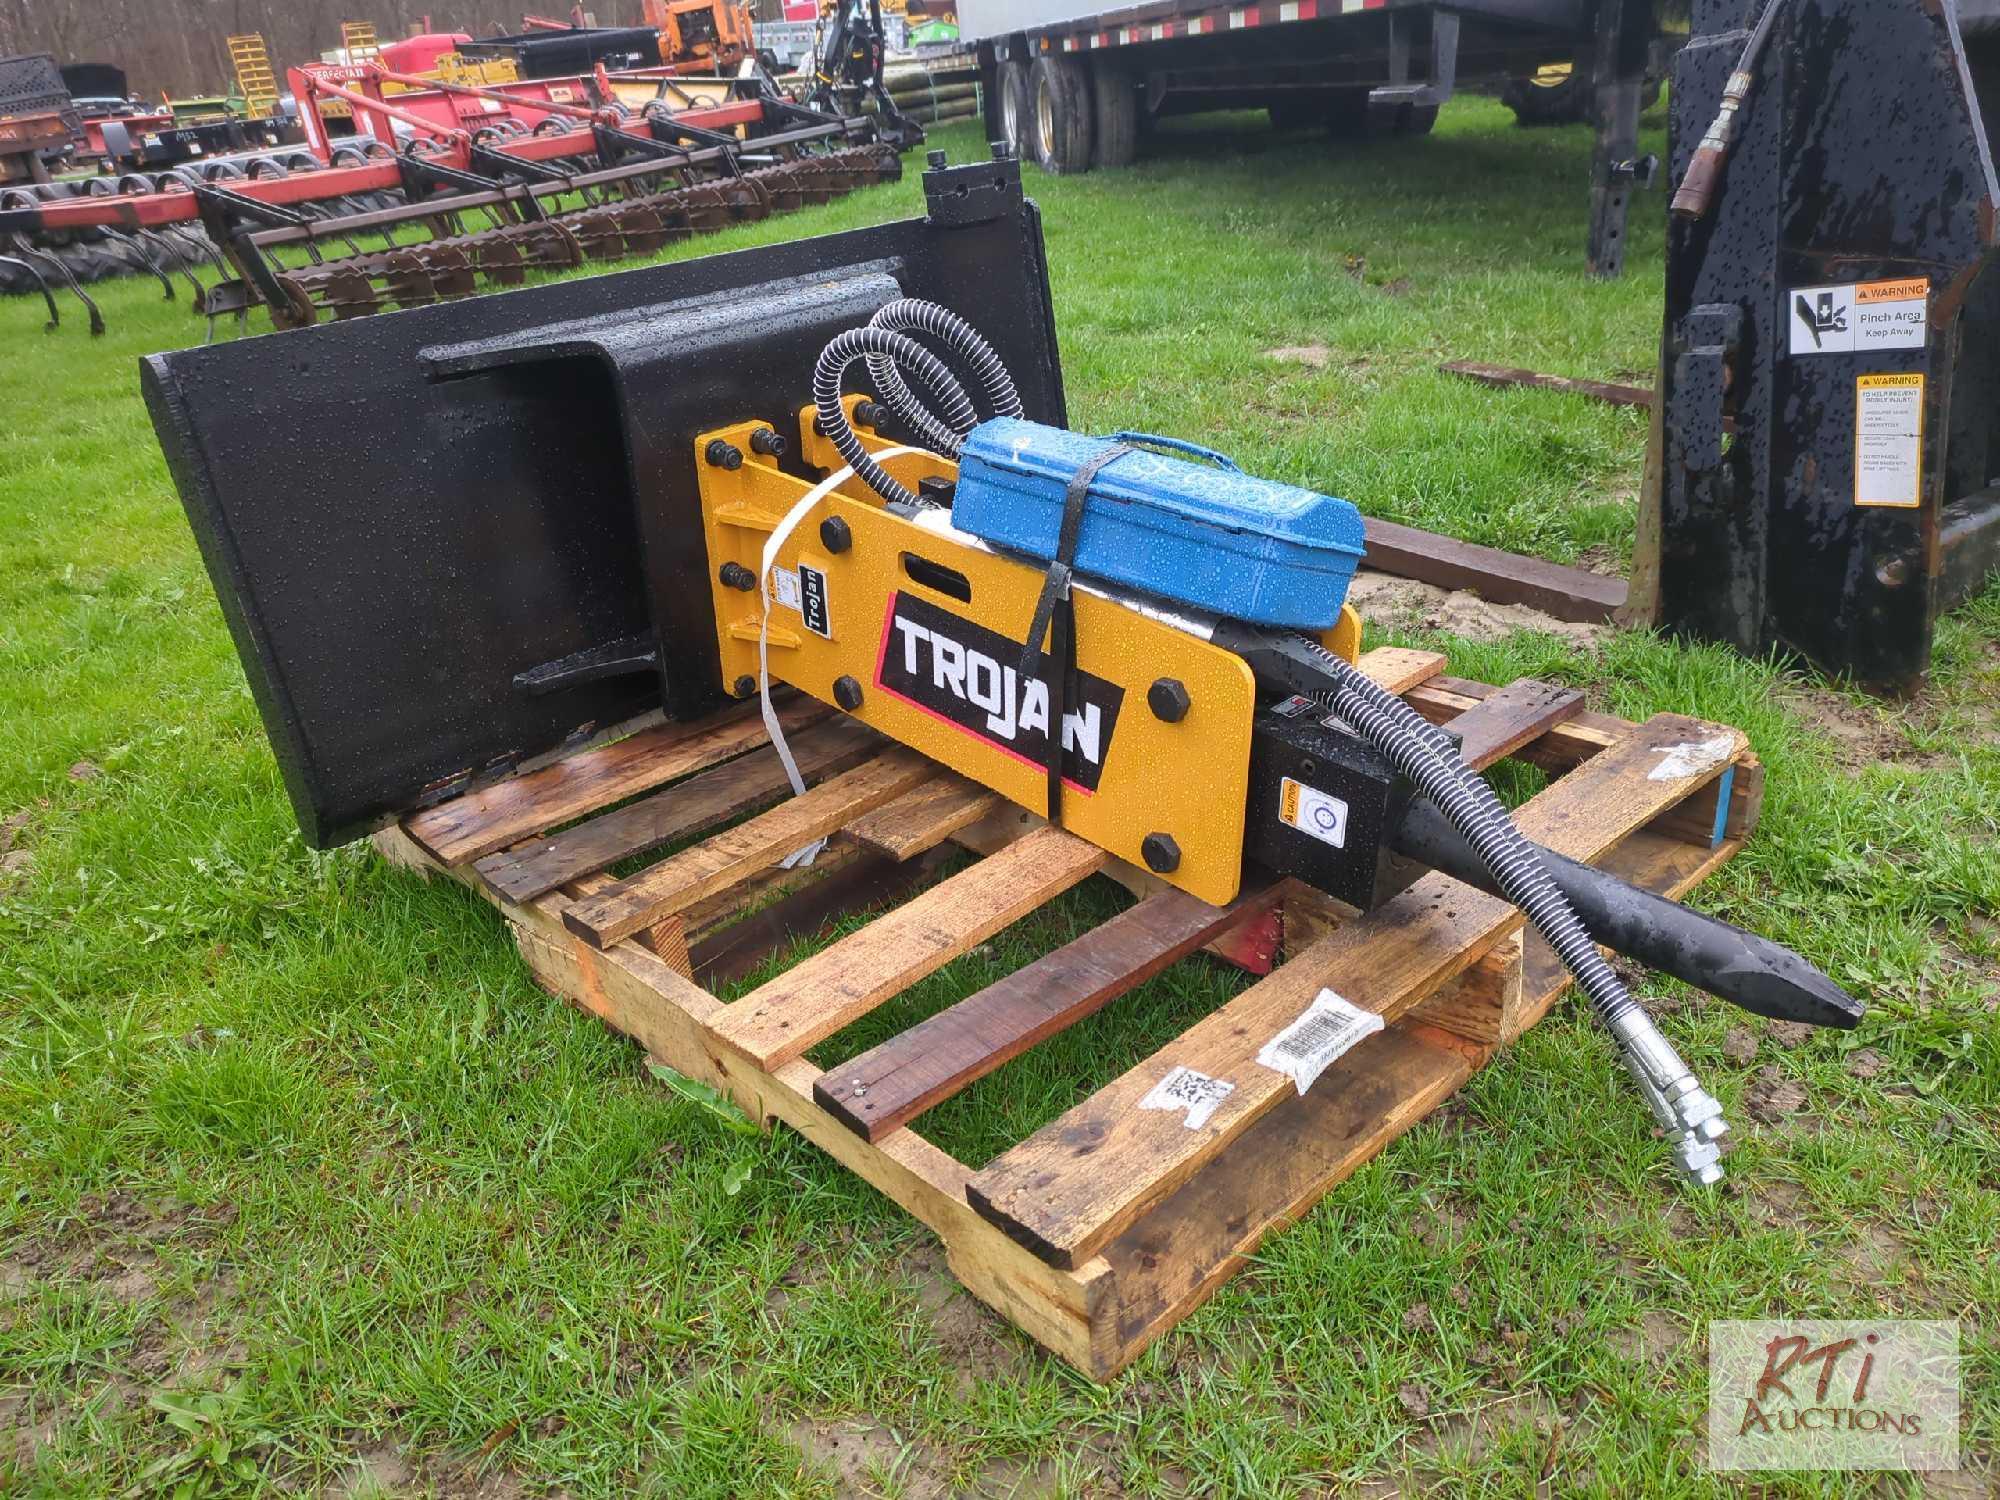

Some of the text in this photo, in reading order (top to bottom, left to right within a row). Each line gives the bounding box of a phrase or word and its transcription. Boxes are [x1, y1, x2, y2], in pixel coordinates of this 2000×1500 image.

[1871, 284, 1924, 298] WARNING
[1860, 311, 1921, 324] Pinch Area
[1865, 328, 1914, 339] Keep Away
[1872, 376, 1919, 386] WARNING
[805, 570, 821, 628] Trojan
[894, 614, 1102, 766] TROJAN
[1287, 783, 1297, 813] CAUTION
